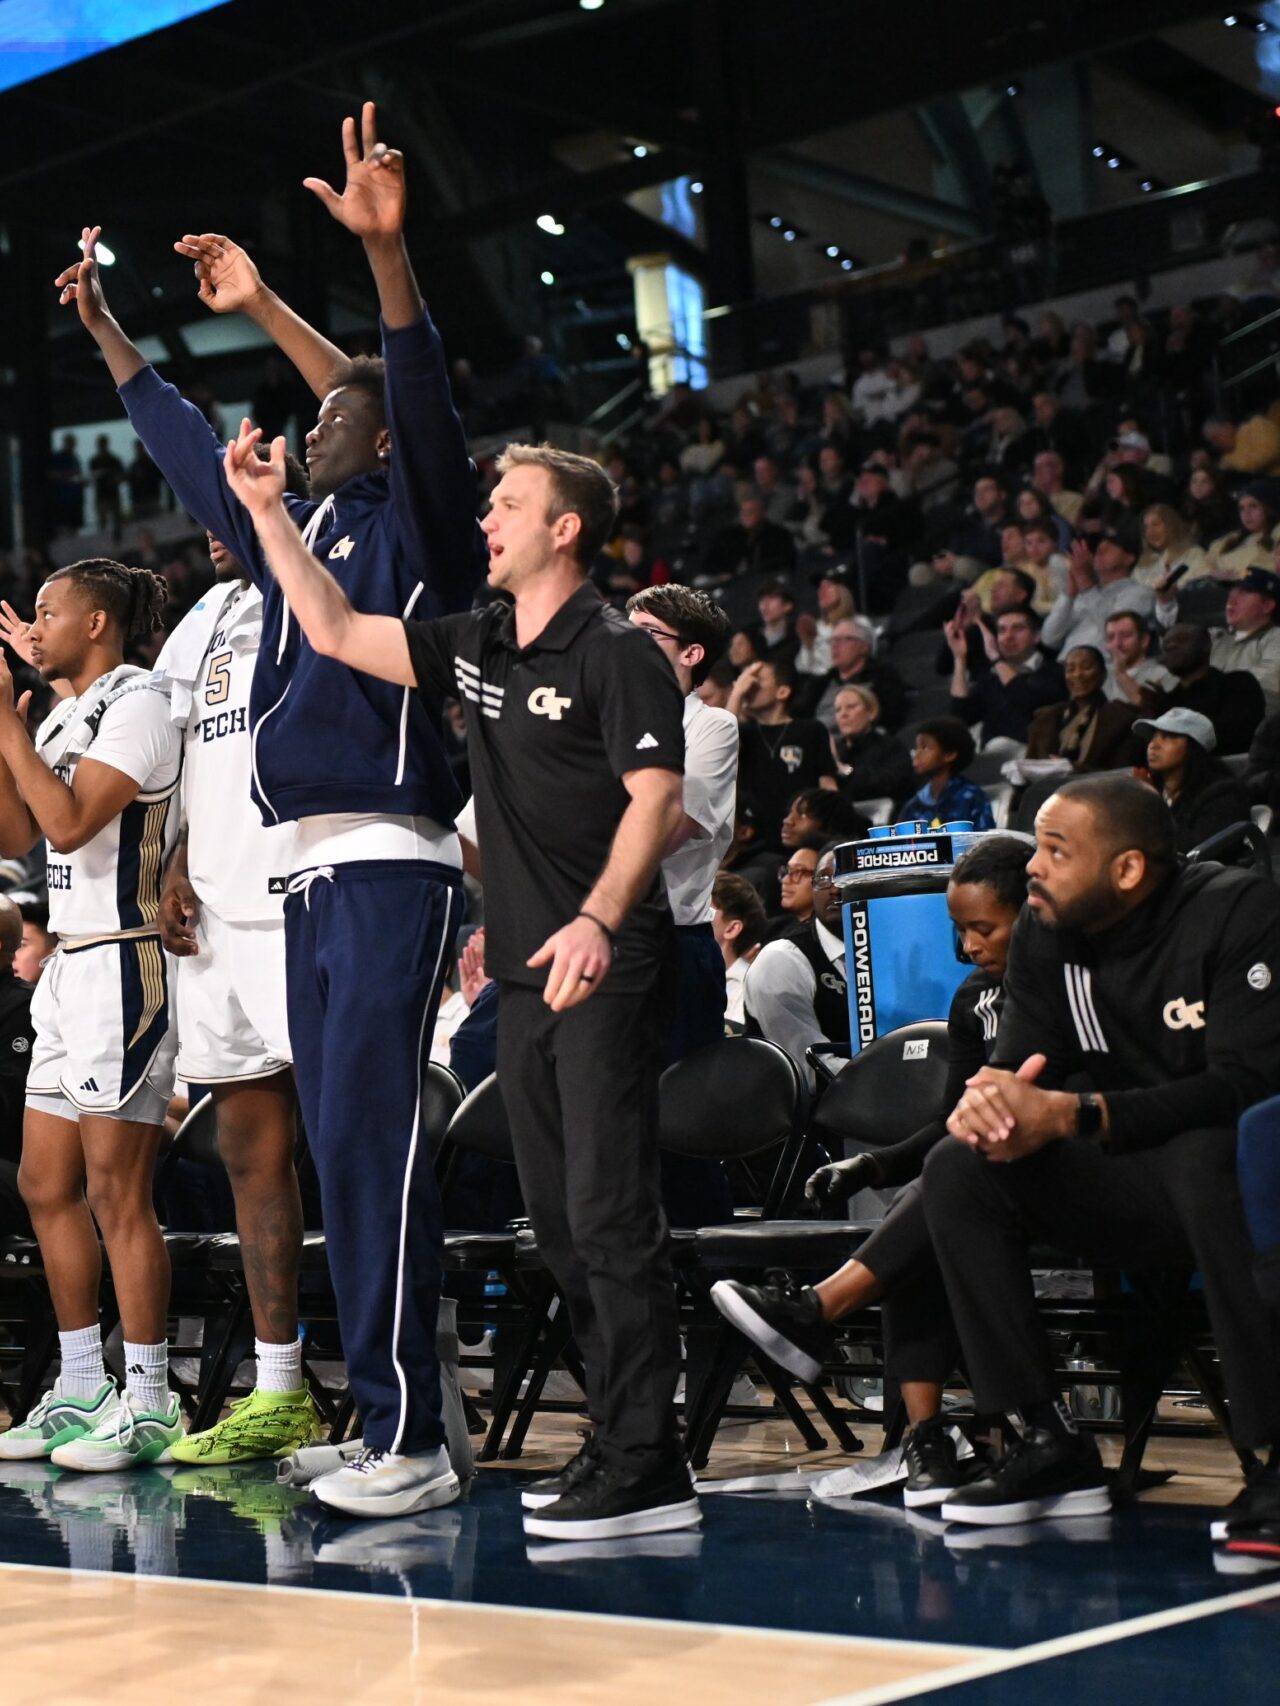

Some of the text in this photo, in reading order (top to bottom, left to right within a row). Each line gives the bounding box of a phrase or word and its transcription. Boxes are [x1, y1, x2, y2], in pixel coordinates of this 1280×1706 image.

[205, 650, 233, 706] 5
[527, 686, 572, 721] GT
[857, 849, 938, 869] POWERADE
[46, 863, 72, 890] ECH
[1163, 996, 1207, 1030] GT
